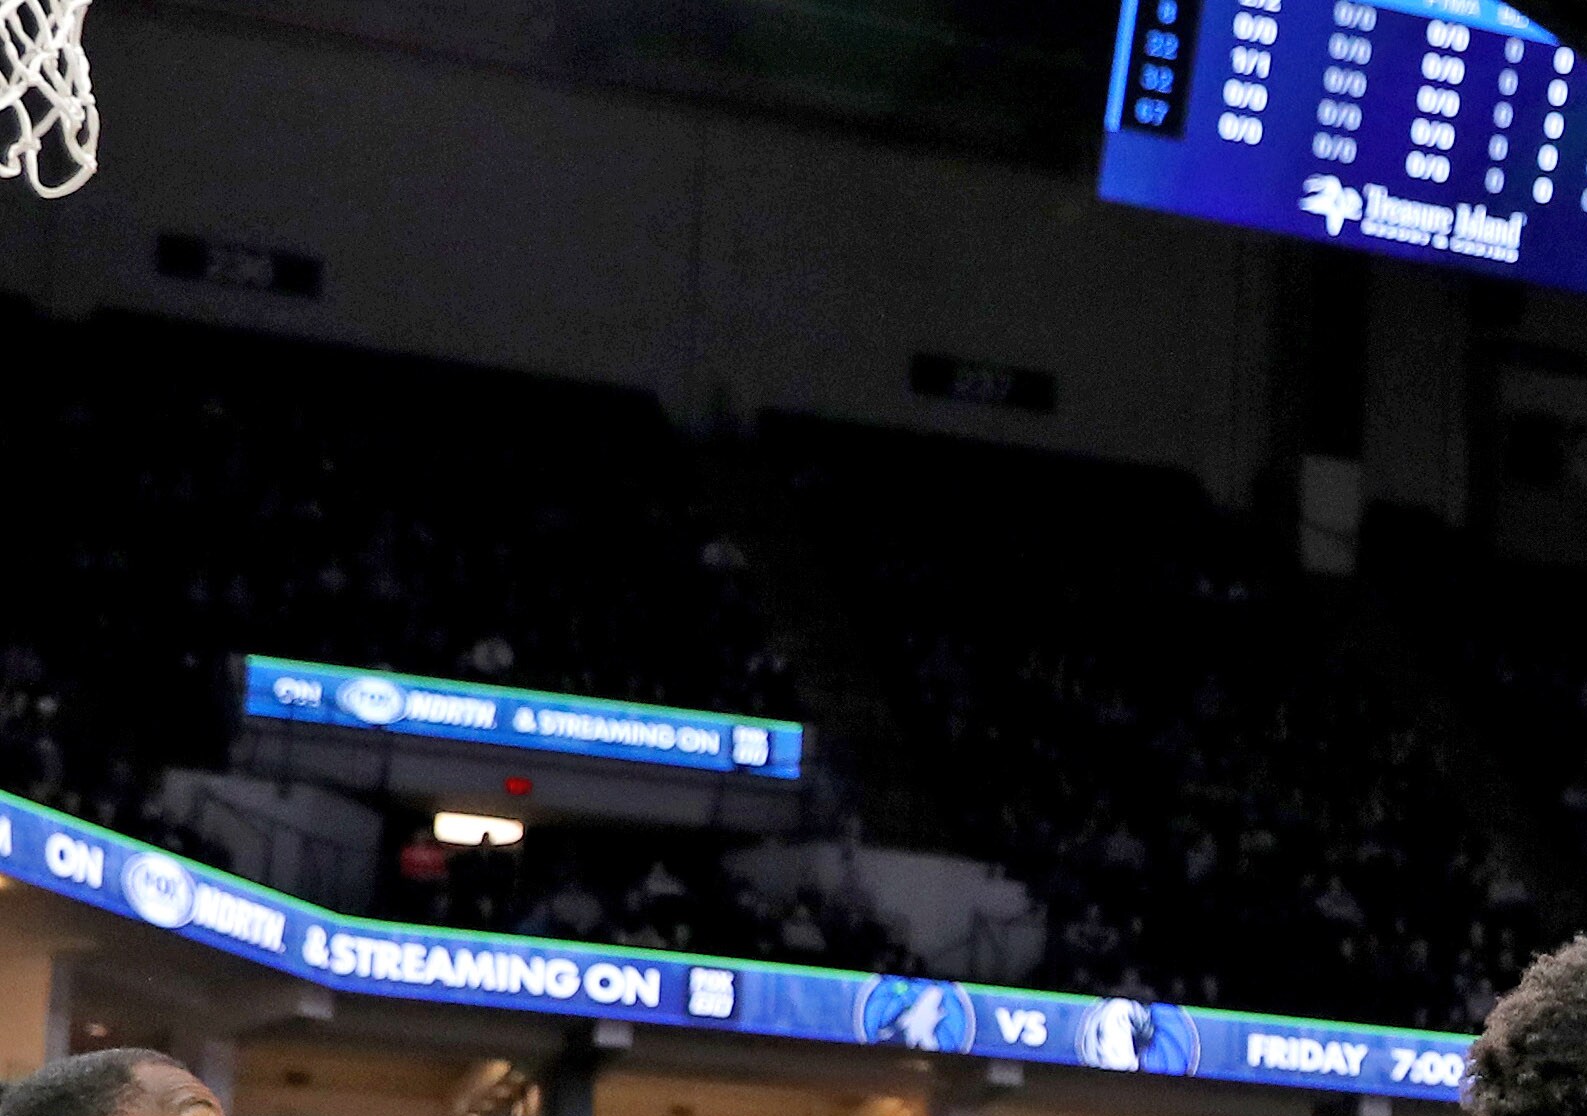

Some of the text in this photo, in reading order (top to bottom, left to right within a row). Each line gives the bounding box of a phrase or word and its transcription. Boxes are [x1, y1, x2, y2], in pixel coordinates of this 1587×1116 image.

[1233, 11, 1278, 45] 0/0
[1328, 32, 1372, 65] 0/0
[1421, 52, 1465, 85] 0/0
[1498, 68, 1519, 96] 0
[1547, 79, 1568, 107] 0
[1333, 1, 1377, 32] 0/0
[1426, 19, 1470, 52] 0/0
[1504, 37, 1525, 63] 0
[1553, 46, 1575, 74] 0
[1223, 78, 1268, 112] 0/0
[1316, 98, 1363, 131] 0/0
[1410, 117, 1456, 150] 0/0
[1488, 134, 1509, 161] 0
[1537, 144, 1559, 172] 0
[1323, 65, 1368, 98] 0/0
[1416, 84, 1460, 118] 0/0
[1493, 101, 1514, 129] 0
[1543, 111, 1565, 139] 0
[1218, 111, 1263, 145] 0/0
[1312, 132, 1357, 164] 0/0
[1405, 150, 1450, 183] 0/0
[1484, 167, 1505, 194] 0
[1532, 176, 1554, 204] 0
[404, 690, 496, 729] NORTH
[537, 709, 676, 751] STREAMING
[676, 726, 721, 756] ON
[45, 832, 104, 890] ON
[196, 883, 286, 952] NORTH
[302, 924, 330, 968] &
[330, 932, 582, 999] STREAMING
[584, 962, 661, 1008] ON
[995, 1006, 1464, 1087] VS FRIDAY 7:00
